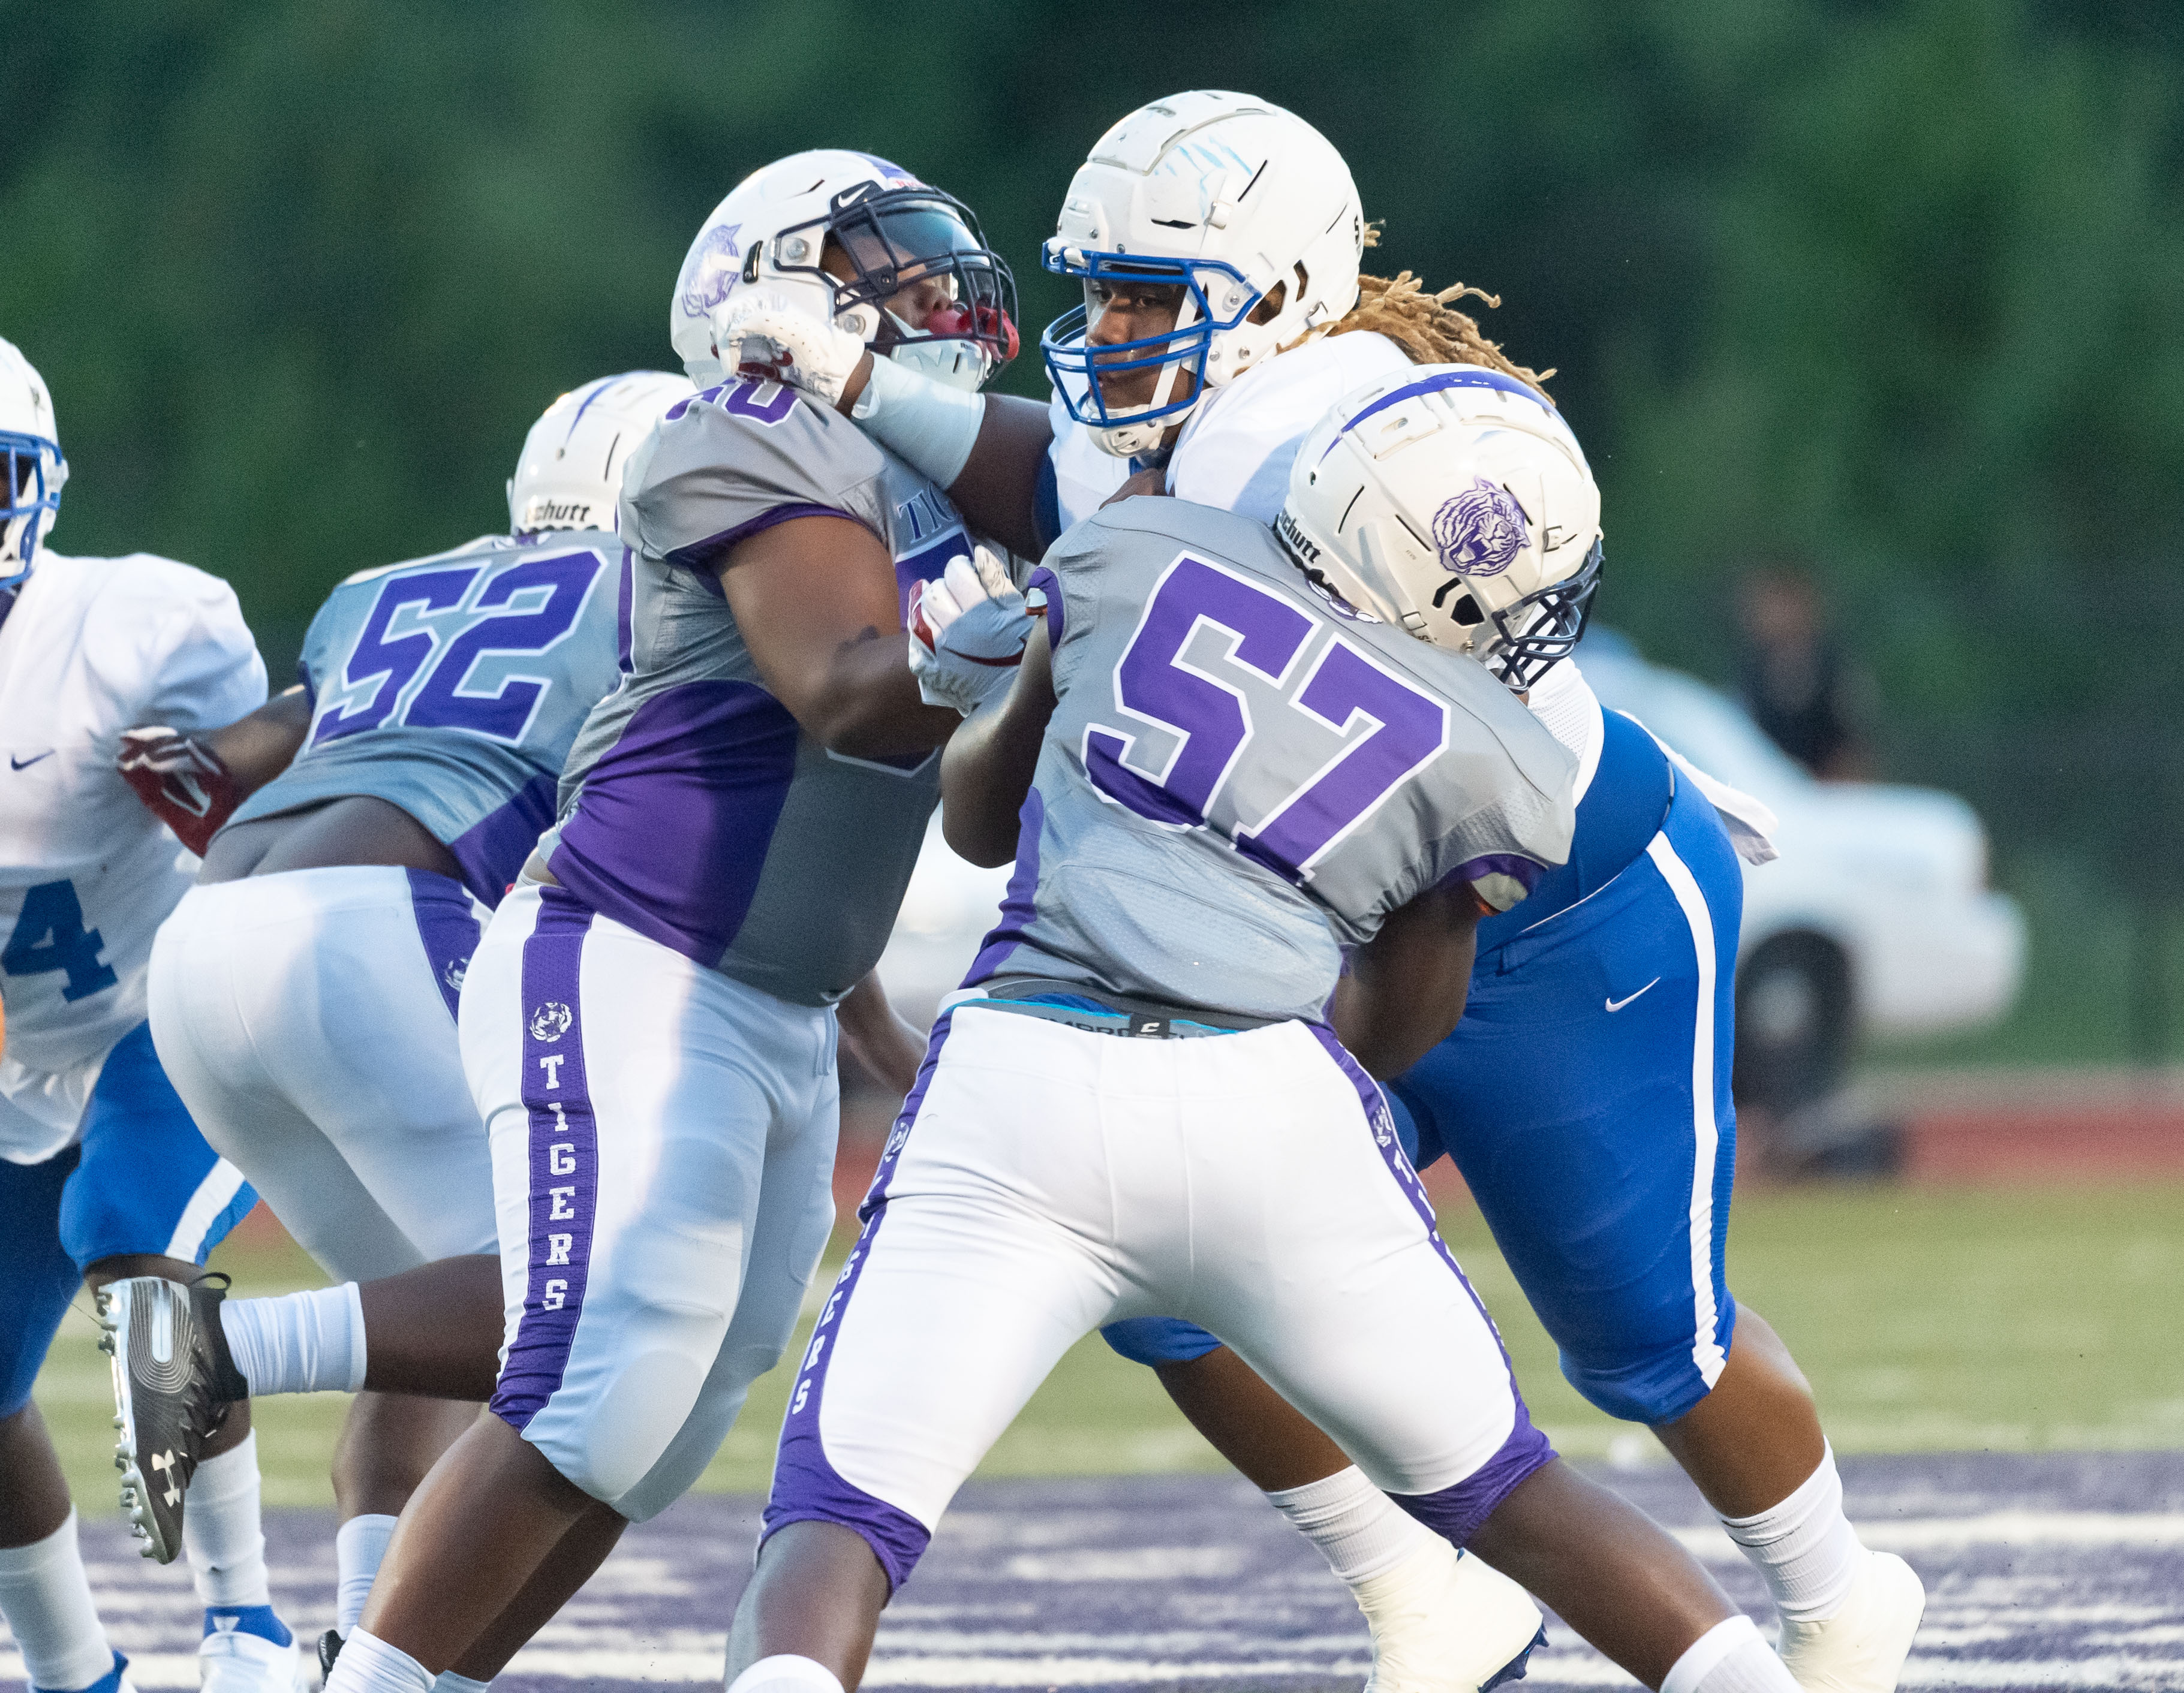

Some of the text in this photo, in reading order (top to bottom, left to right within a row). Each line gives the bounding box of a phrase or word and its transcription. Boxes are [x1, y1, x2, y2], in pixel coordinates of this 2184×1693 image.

[524, 498, 591, 525] chutt
[305, 546, 608, 754] 52
[1080, 549, 1451, 888] 57
[2, 878, 118, 1004] 4
[540, 1053, 576, 1311] TIGERS
